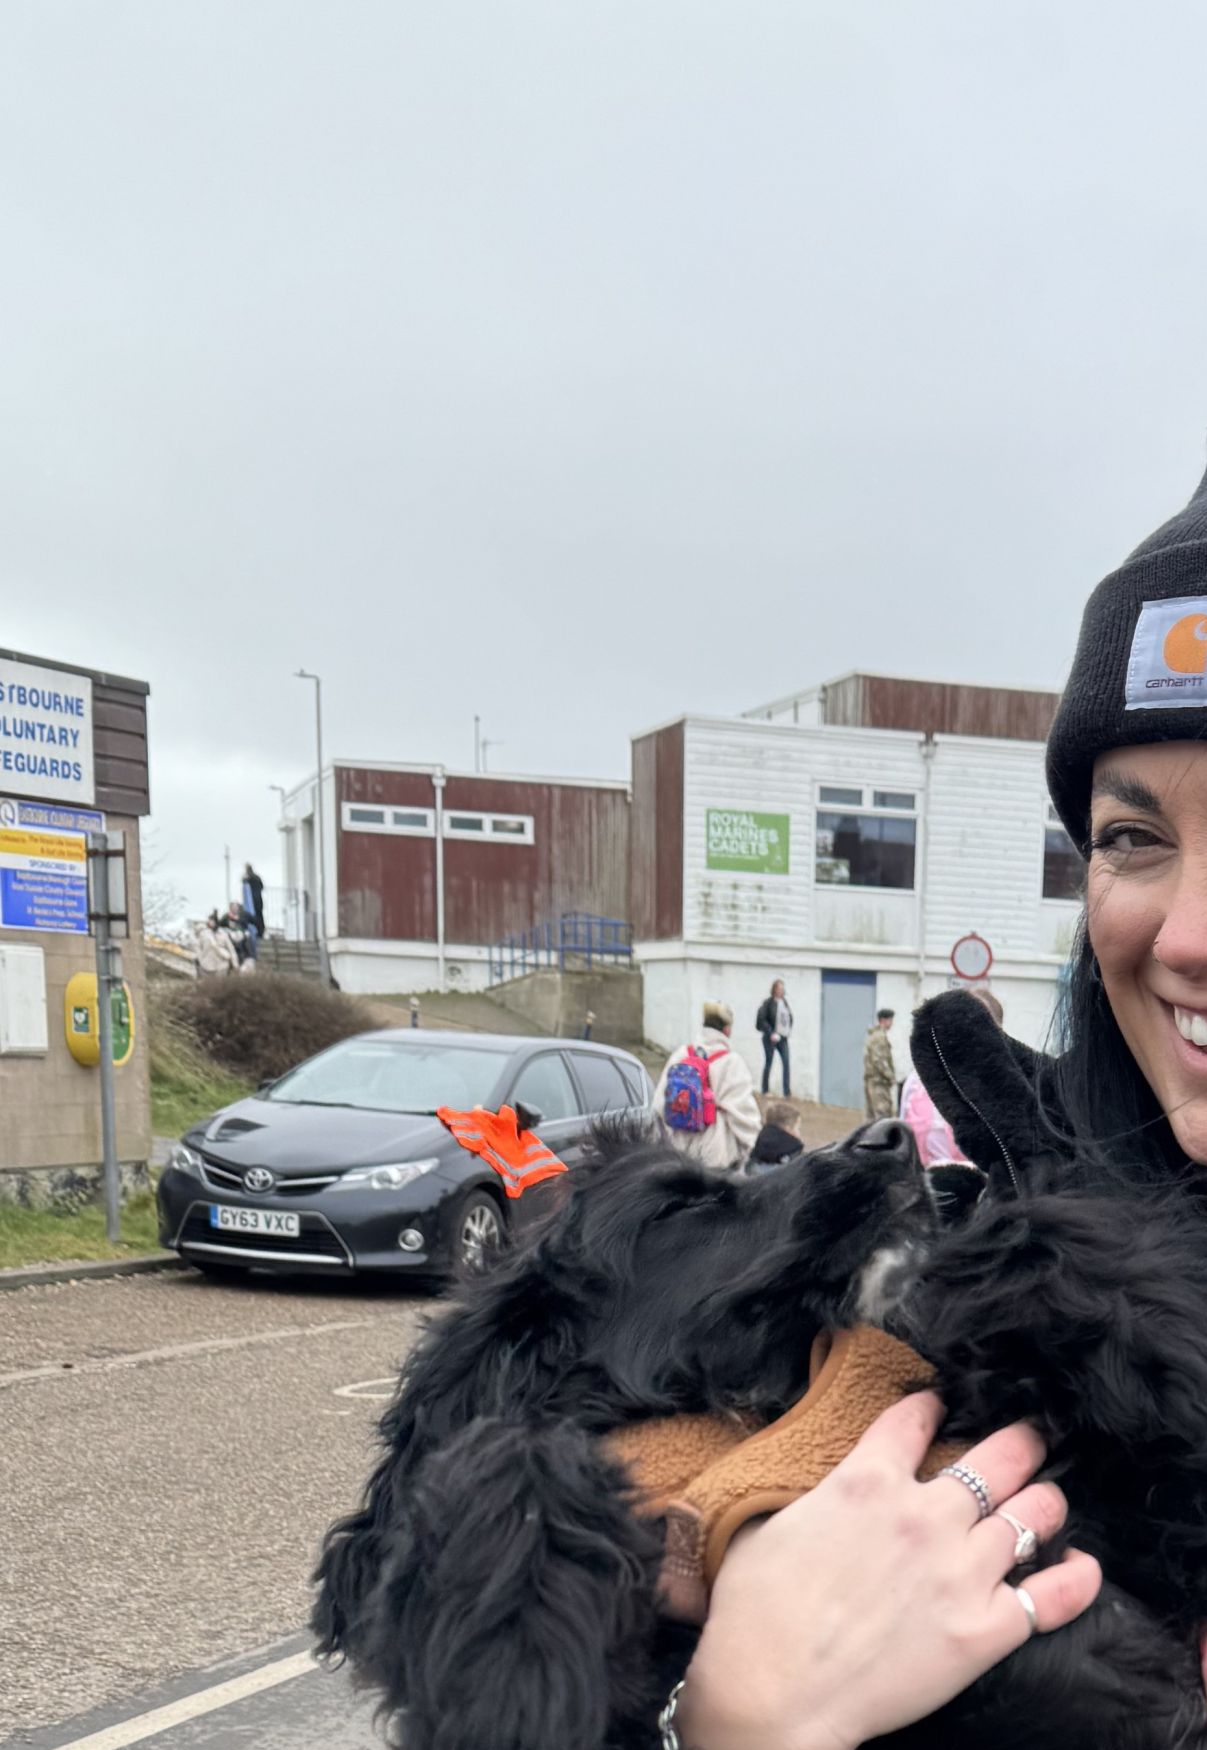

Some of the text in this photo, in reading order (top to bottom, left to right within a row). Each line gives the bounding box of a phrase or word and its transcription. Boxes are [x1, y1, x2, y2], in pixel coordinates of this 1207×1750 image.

[1145, 677, 1205, 689] carhartt
[0, 715, 79, 748] LUNTARY
[0, 749, 82, 781] EGUARDS
[709, 813, 757, 827] ROYAL
[709, 826, 779, 843] MARINES
[709, 839, 769, 856] CADETS
[220, 1208, 296, 1232] GY63 VXC
